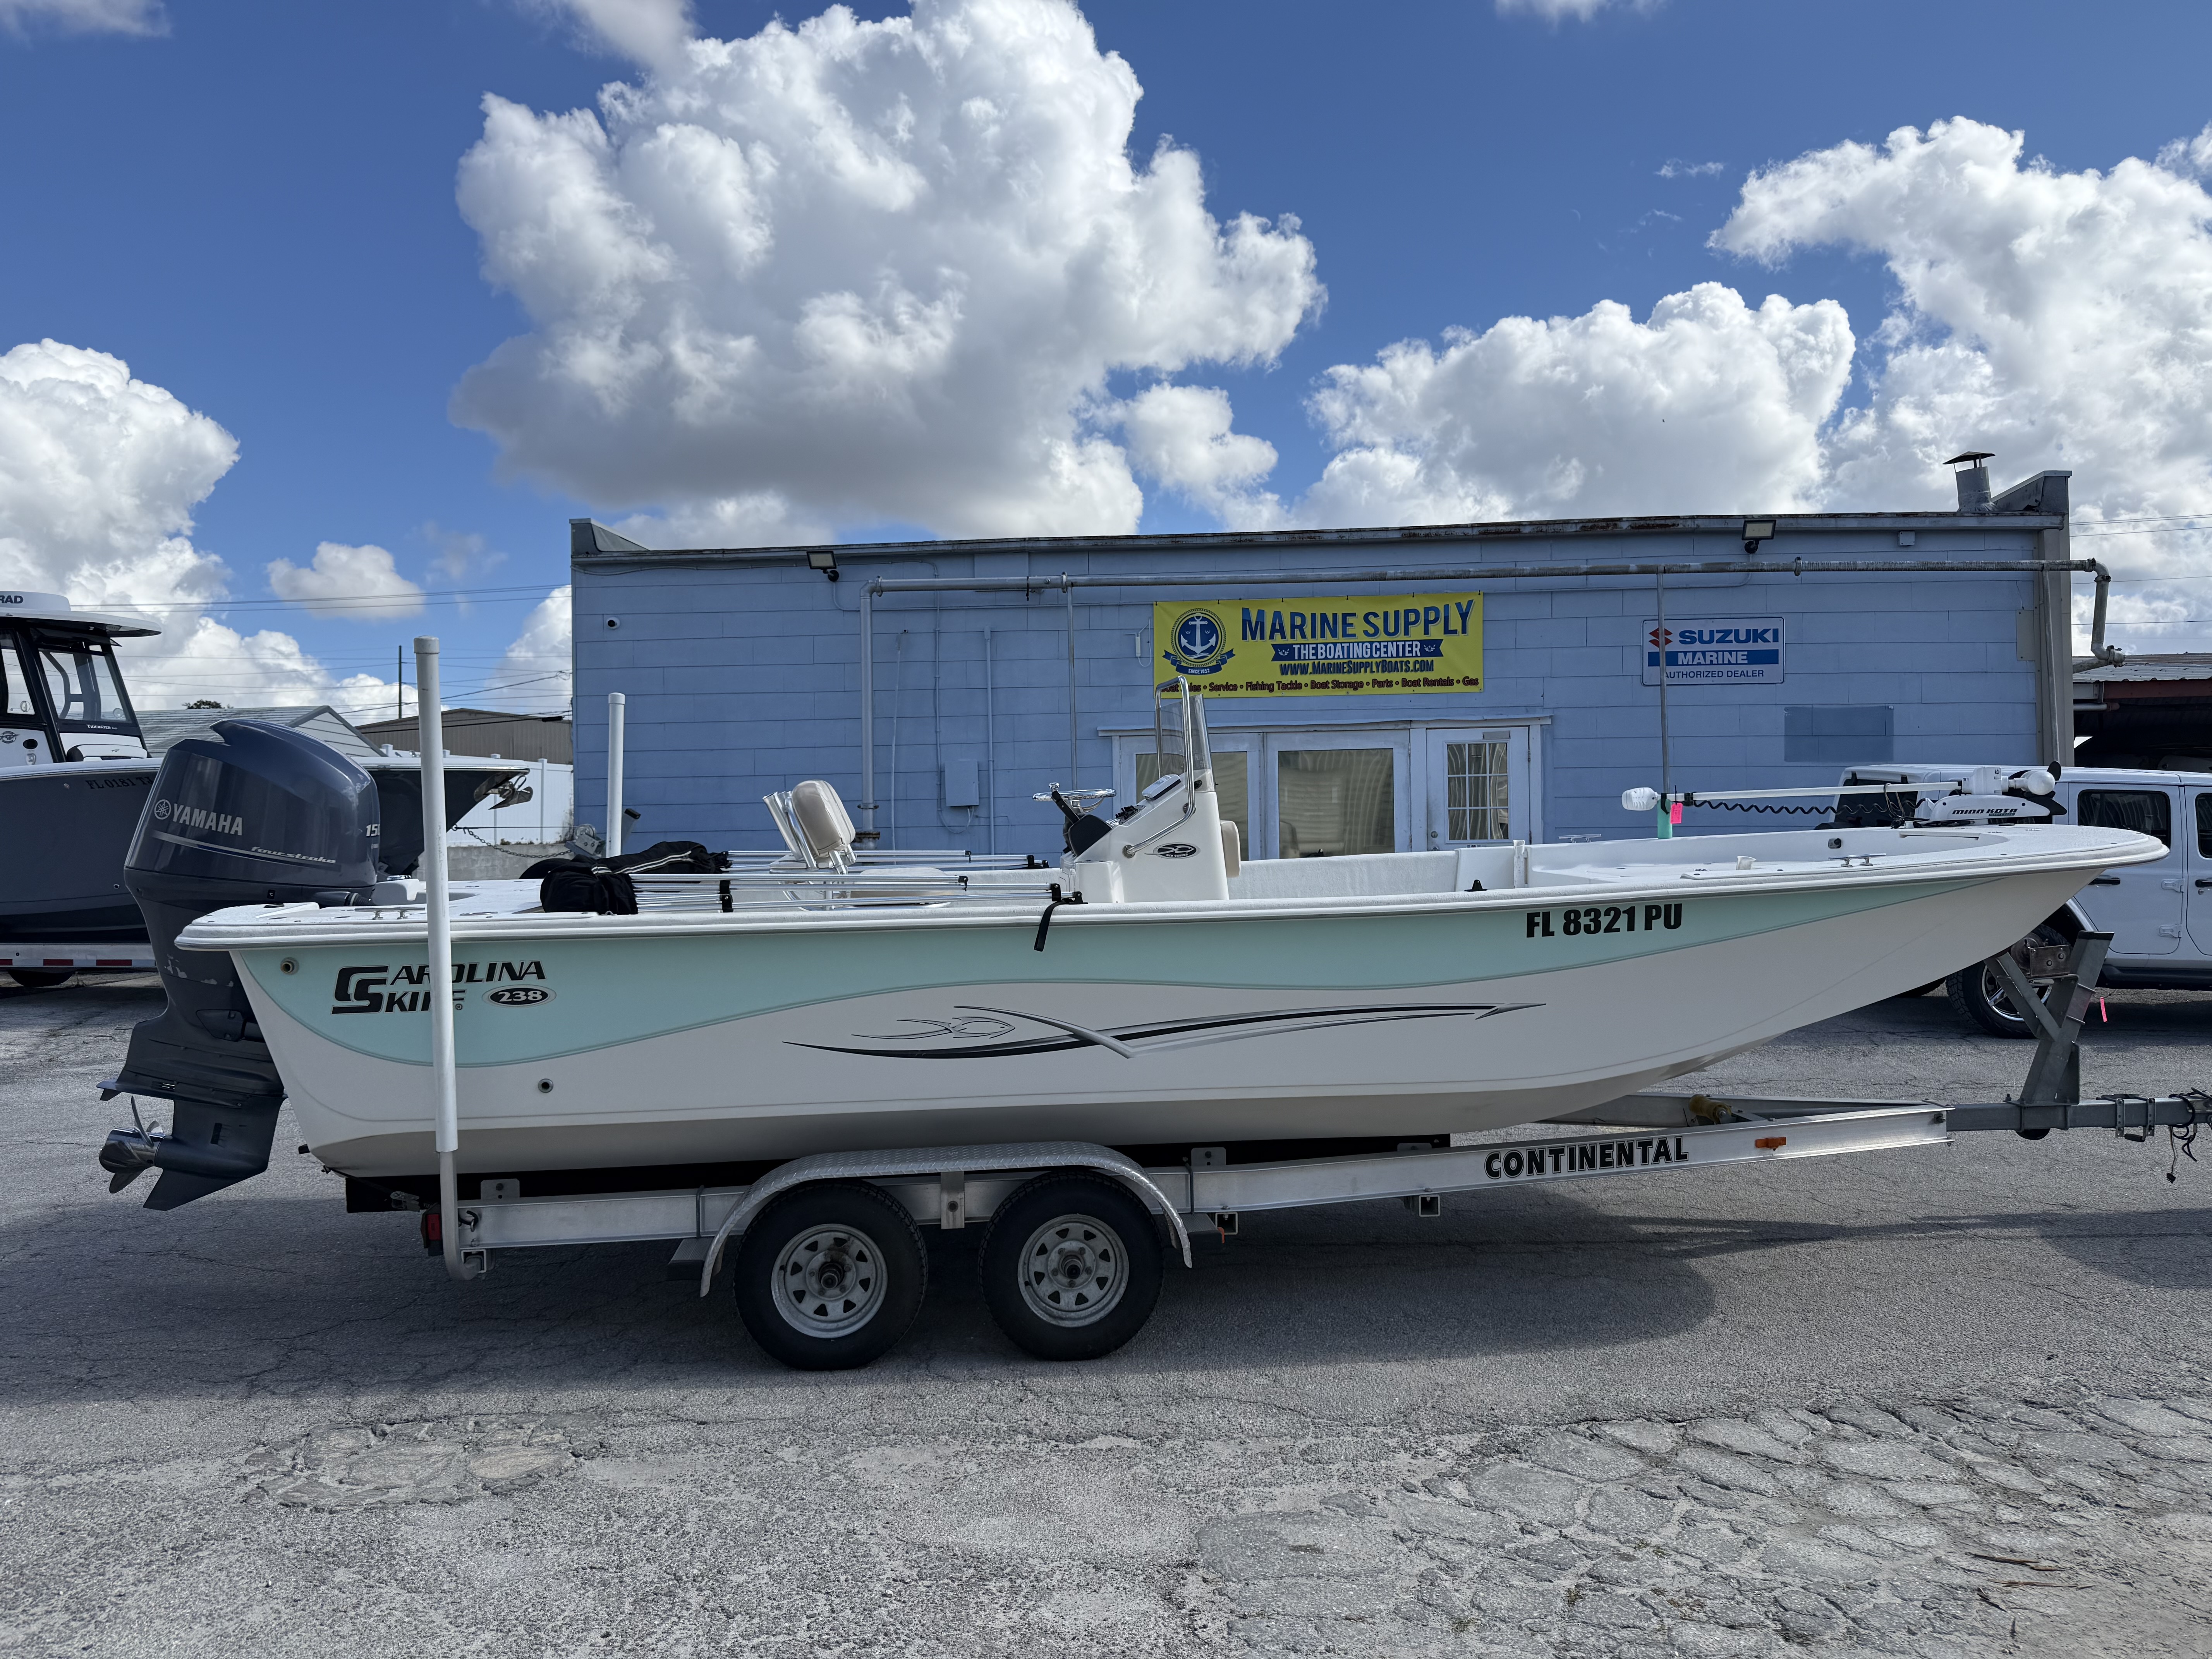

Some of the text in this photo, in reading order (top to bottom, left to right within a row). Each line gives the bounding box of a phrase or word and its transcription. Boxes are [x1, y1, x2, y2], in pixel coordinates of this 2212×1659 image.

[1242, 599, 1474, 641] MARINE SUPPLY
[1679, 628, 1779, 645] SUZUKI
[1293, 641, 1420, 659] THE BOATING CENTER
[1678, 651, 1748, 665] MARINE
[1209, 682, 1238, 691] Service
[1246, 682, 1274, 692] Fishing
[1276, 680, 1302, 690] Tackle
[1310, 680, 1330, 689] Boat
[1331, 680, 1364, 690] Storage
[1372, 679, 1393, 688] Parts
[1401, 678, 1421, 687] Boat
[1423, 677, 1454, 687] Rentals
[1462, 676, 1479, 686] Gas
[85, 780, 104, 789] FL
[104, 778, 136, 788] 0181
[173, 804, 242, 836] YAMAHA
[1527, 903, 1682, 938] FL 8321 PU
[498, 990, 543, 1002] 238
[1484, 1136, 1689, 1179] CONTINENTAL
